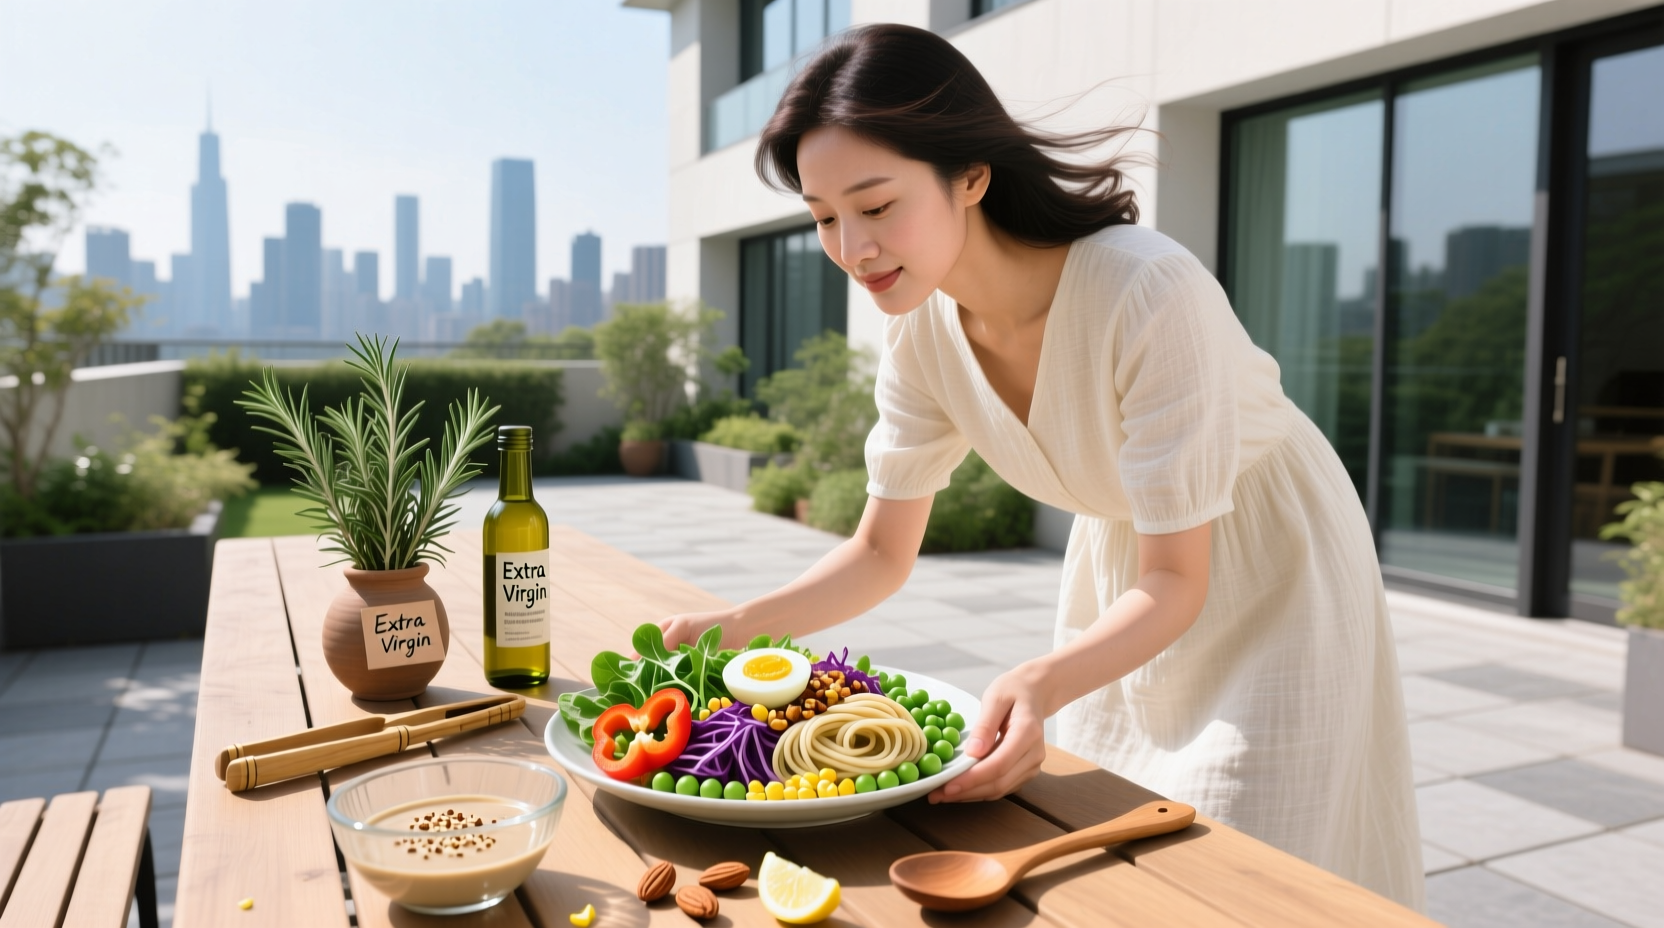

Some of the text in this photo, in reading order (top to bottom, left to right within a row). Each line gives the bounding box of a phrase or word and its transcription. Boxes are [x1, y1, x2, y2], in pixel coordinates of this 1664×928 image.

[503, 561, 546, 580] Extra
[503, 583, 547, 609] Virgin
[374, 613, 426, 635] Extra
[381, 632, 431, 658] Virgin
